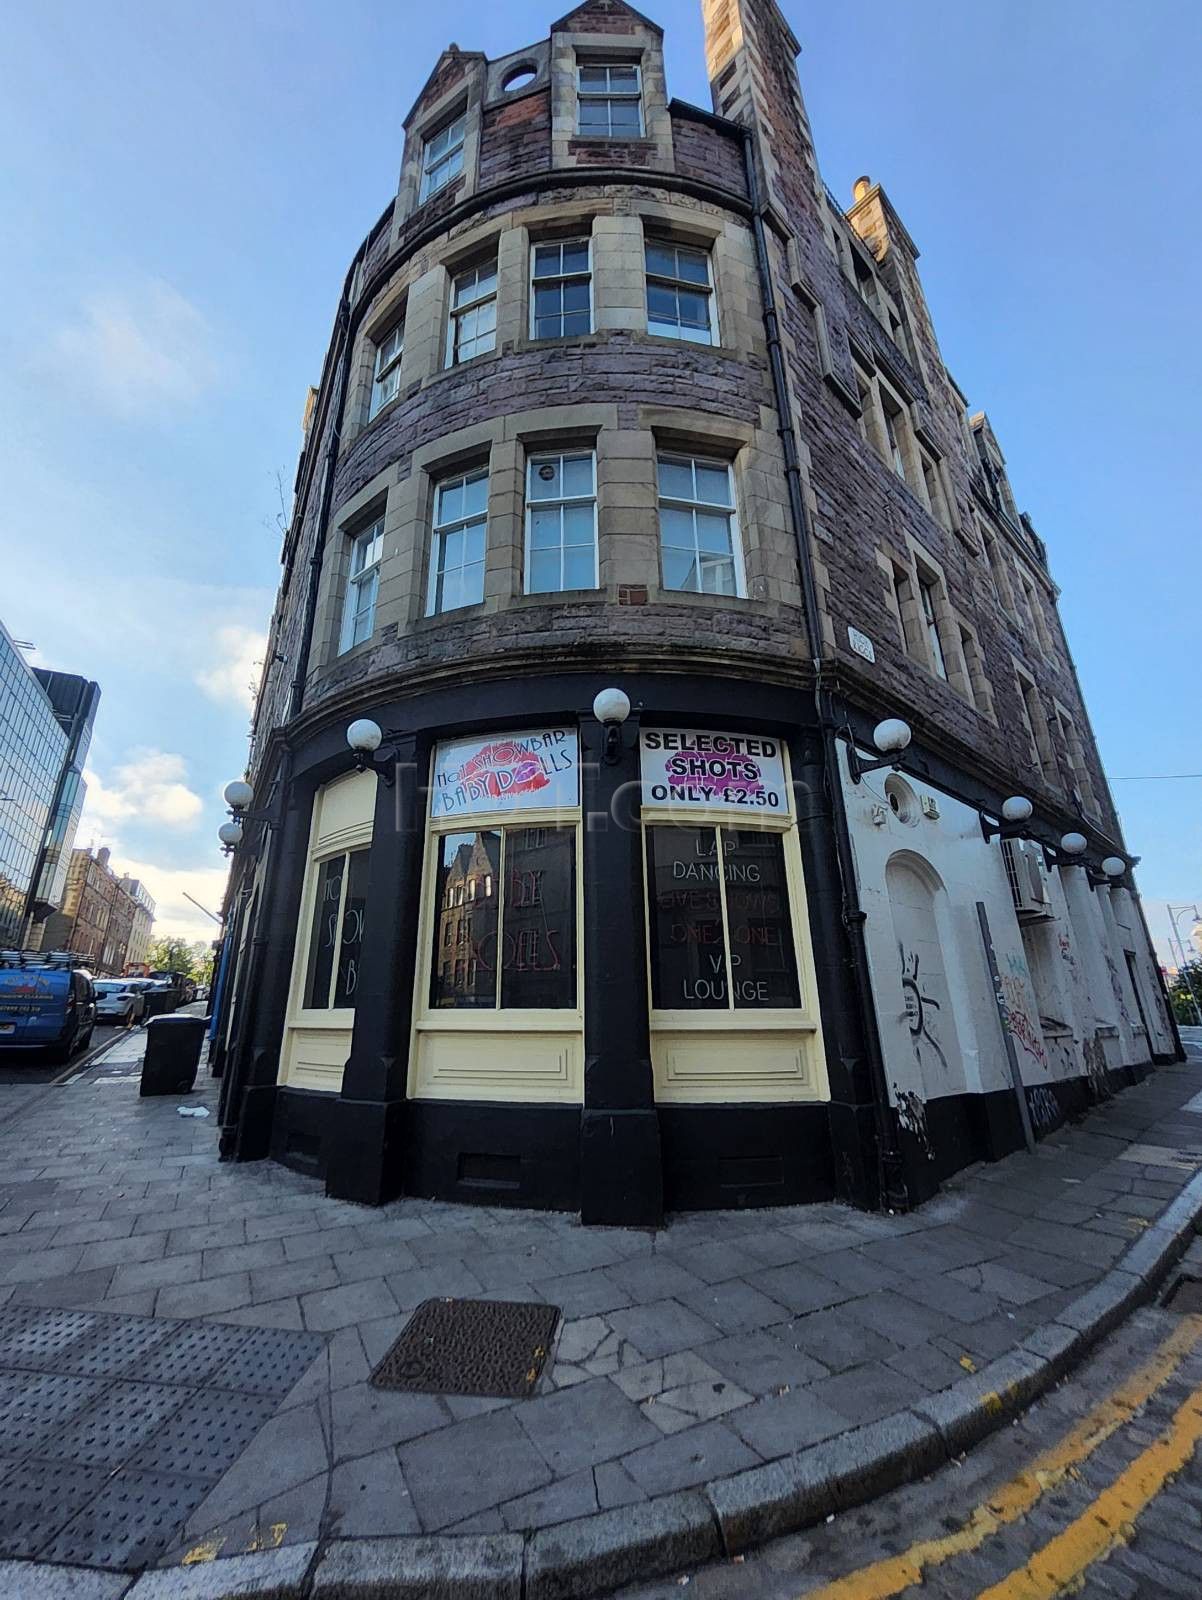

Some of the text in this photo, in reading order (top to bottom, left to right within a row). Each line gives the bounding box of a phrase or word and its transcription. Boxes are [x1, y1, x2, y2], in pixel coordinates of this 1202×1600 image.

[645, 732, 776, 758] SELECTED
[671, 757, 759, 780] SHOTS
[442, 774, 489, 811] BABY
[651, 784, 779, 807] ONLY £2.50
[673, 860, 761, 882] DANCING
